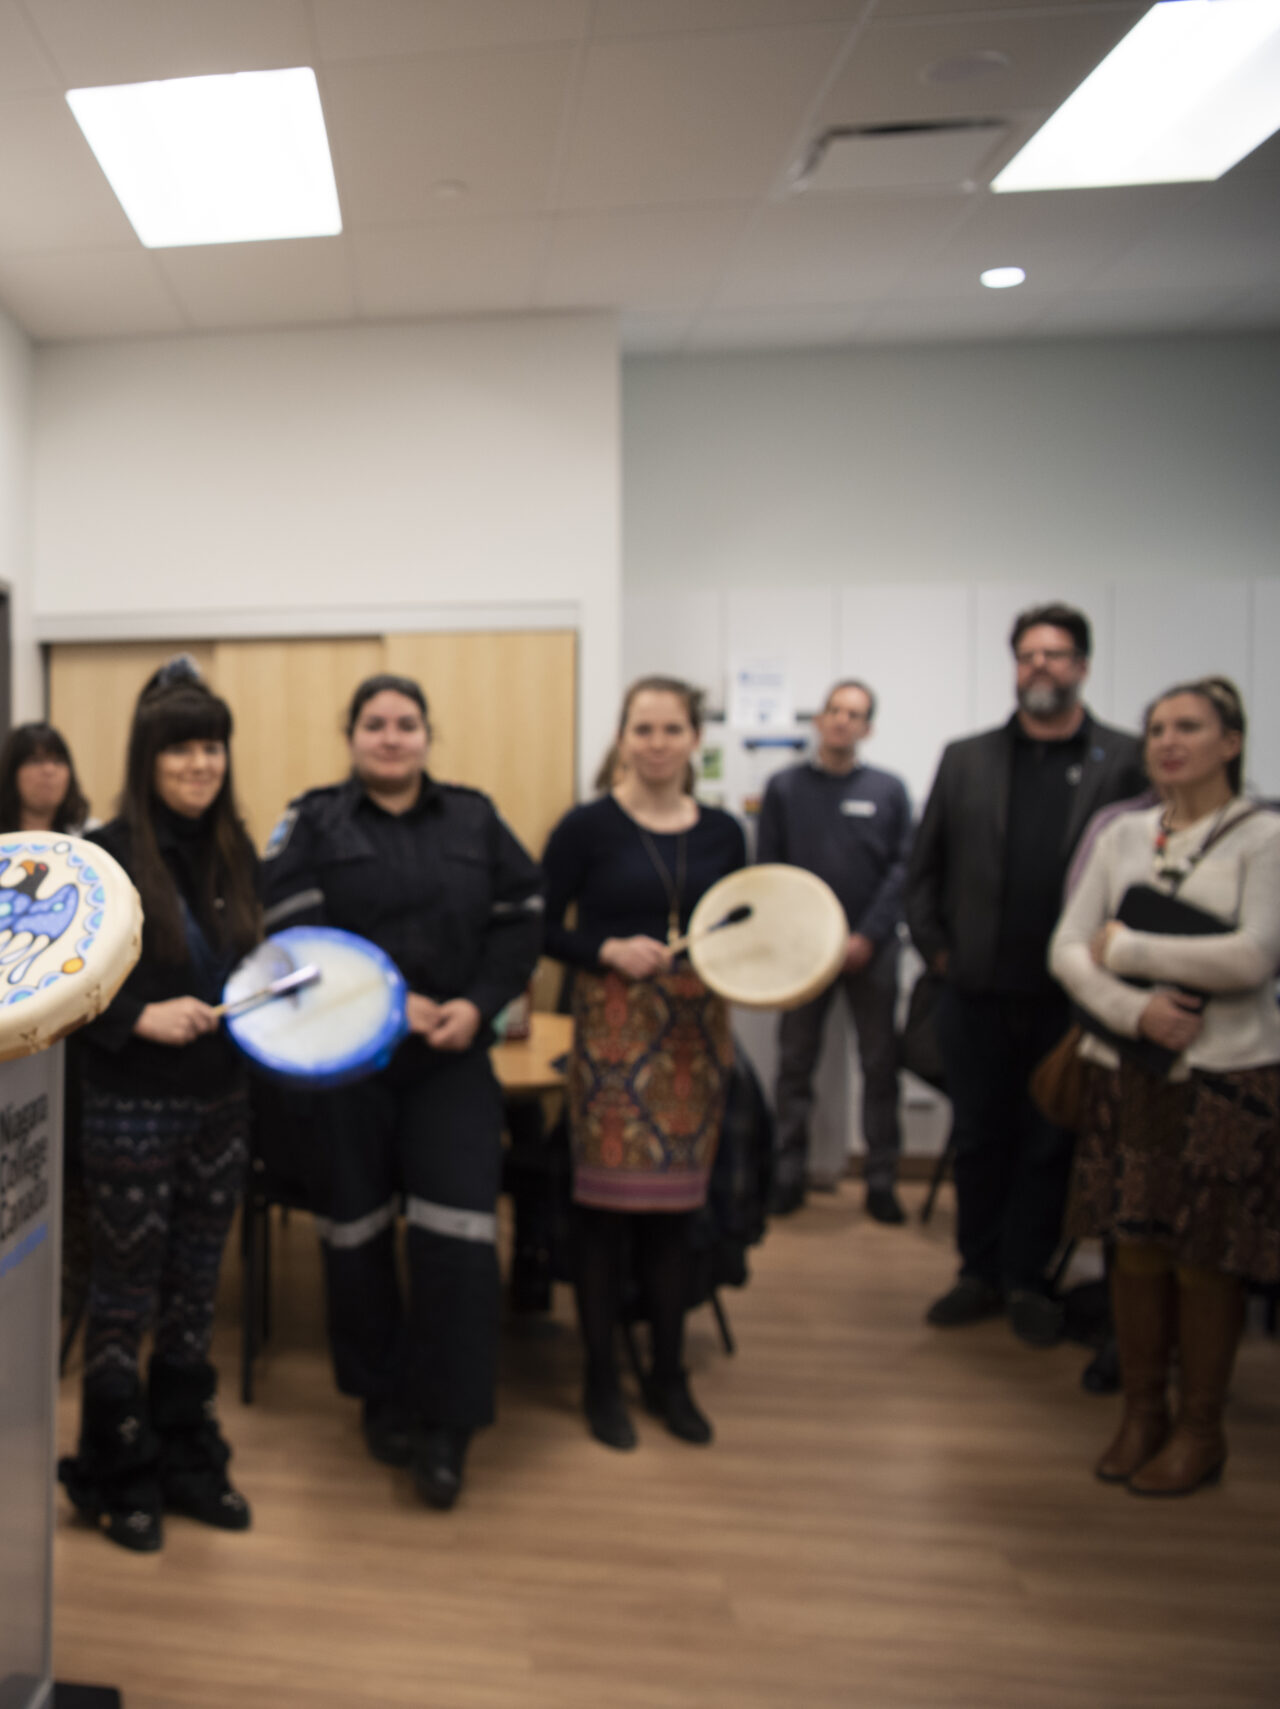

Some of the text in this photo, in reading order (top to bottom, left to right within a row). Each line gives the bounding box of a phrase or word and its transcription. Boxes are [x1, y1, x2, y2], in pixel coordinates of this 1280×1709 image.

[0, 1094, 48, 1145] Niagara
[0, 1137, 48, 1195] College
[0, 1178, 48, 1242] Canada
